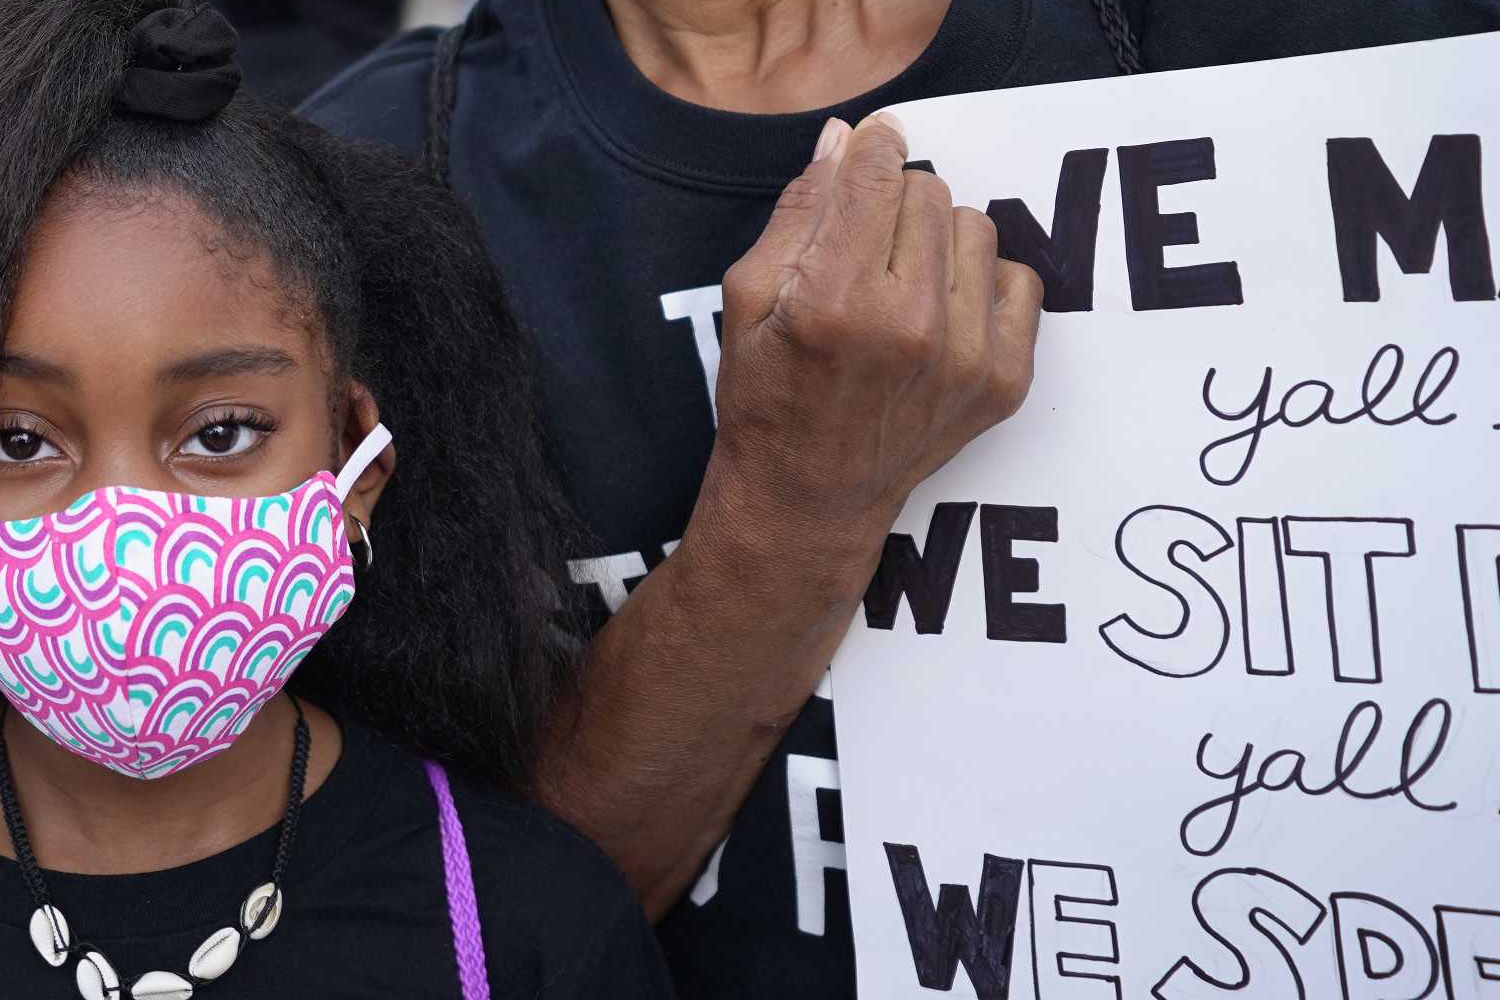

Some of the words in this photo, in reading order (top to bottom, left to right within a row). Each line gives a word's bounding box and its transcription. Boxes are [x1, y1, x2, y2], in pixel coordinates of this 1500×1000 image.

[1325, 133, 1500, 303] M
[1199, 343, 1460, 487] yall
[863, 500, 1068, 644] WE
[1099, 504, 1417, 685] SIT
[1179, 697, 1458, 857] yall
[883, 841, 1123, 1000] WE
